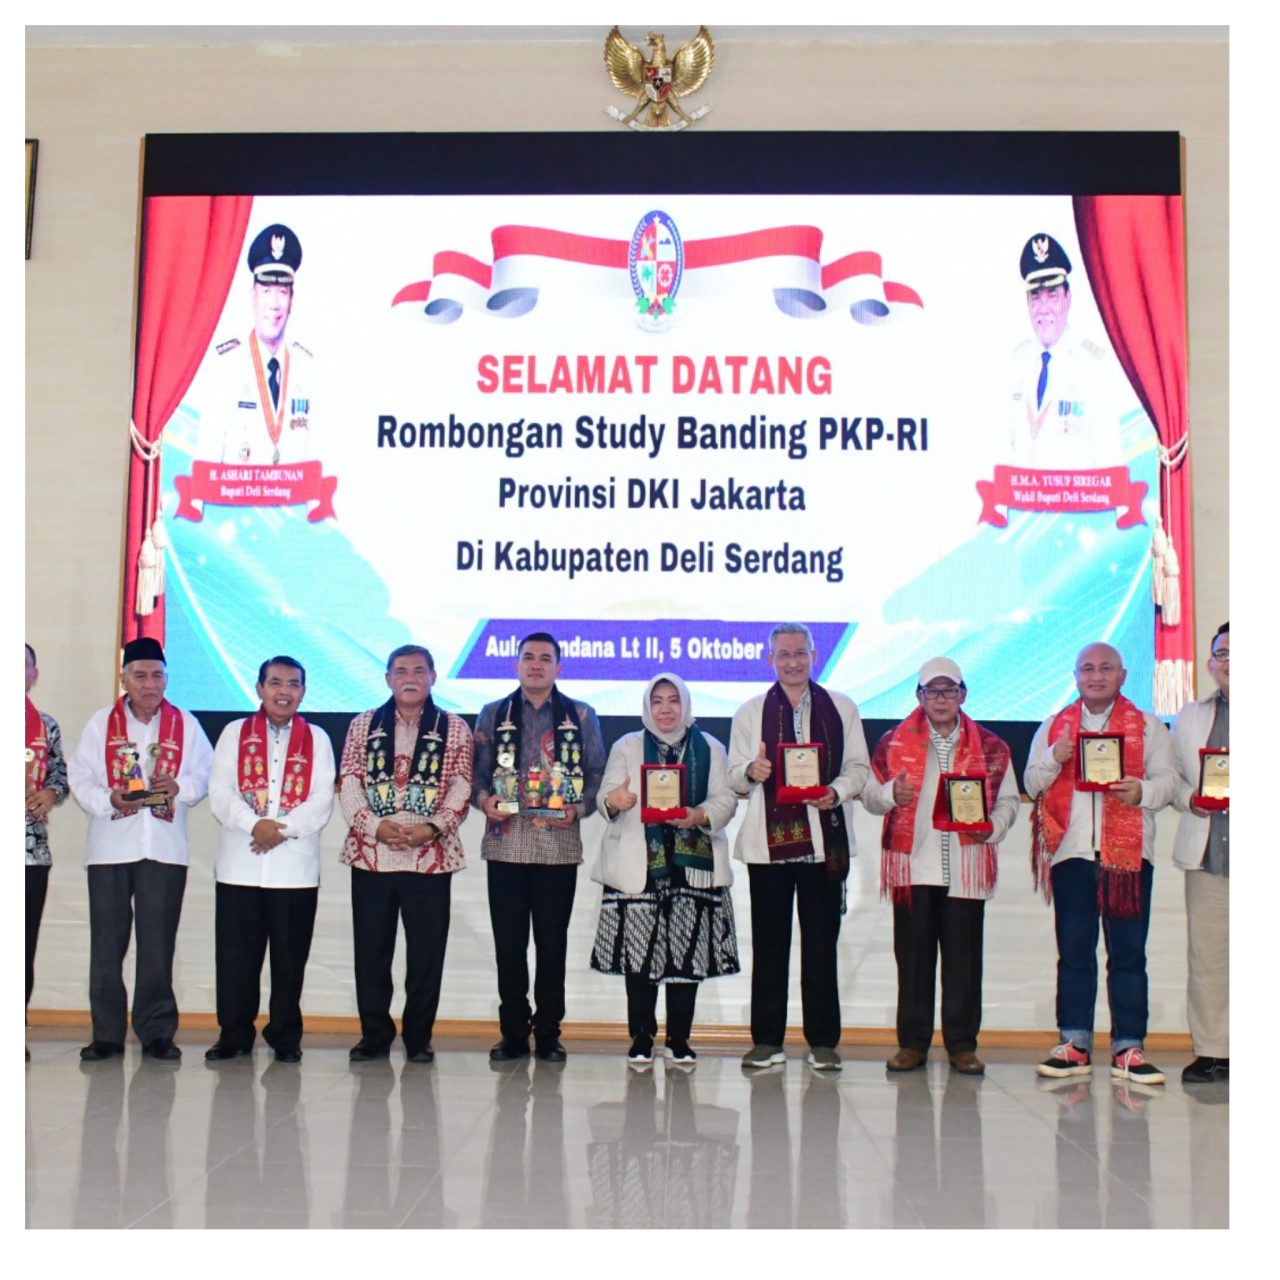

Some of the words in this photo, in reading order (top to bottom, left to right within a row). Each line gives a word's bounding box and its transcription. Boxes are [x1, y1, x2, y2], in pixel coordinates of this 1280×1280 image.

[478, 355, 658, 393] SELAMAT
[673, 356, 831, 395] DATANG
[378, 414, 562, 457] Rombongan
[576, 415, 665, 458] Study
[678, 415, 807, 459] Banding
[820, 417, 927, 450] PKP-RI
[499, 477, 615, 509] Provinsi
[628, 479, 678, 508] DKI
[691, 478, 805, 510] Jakarta
[457, 540, 483, 570] Di
[495, 540, 648, 579] Kabupaten
[661, 542, 713, 573] Deli
[725, 542, 843, 582] Serdang
[486, 636, 520, 657] Aul
[558, 635, 616, 658] ndana
[621, 637, 639, 658] Lt
[646, 637, 663, 663] II,
[670, 637, 681, 659] 5
[688, 637, 764, 659] Oktober
